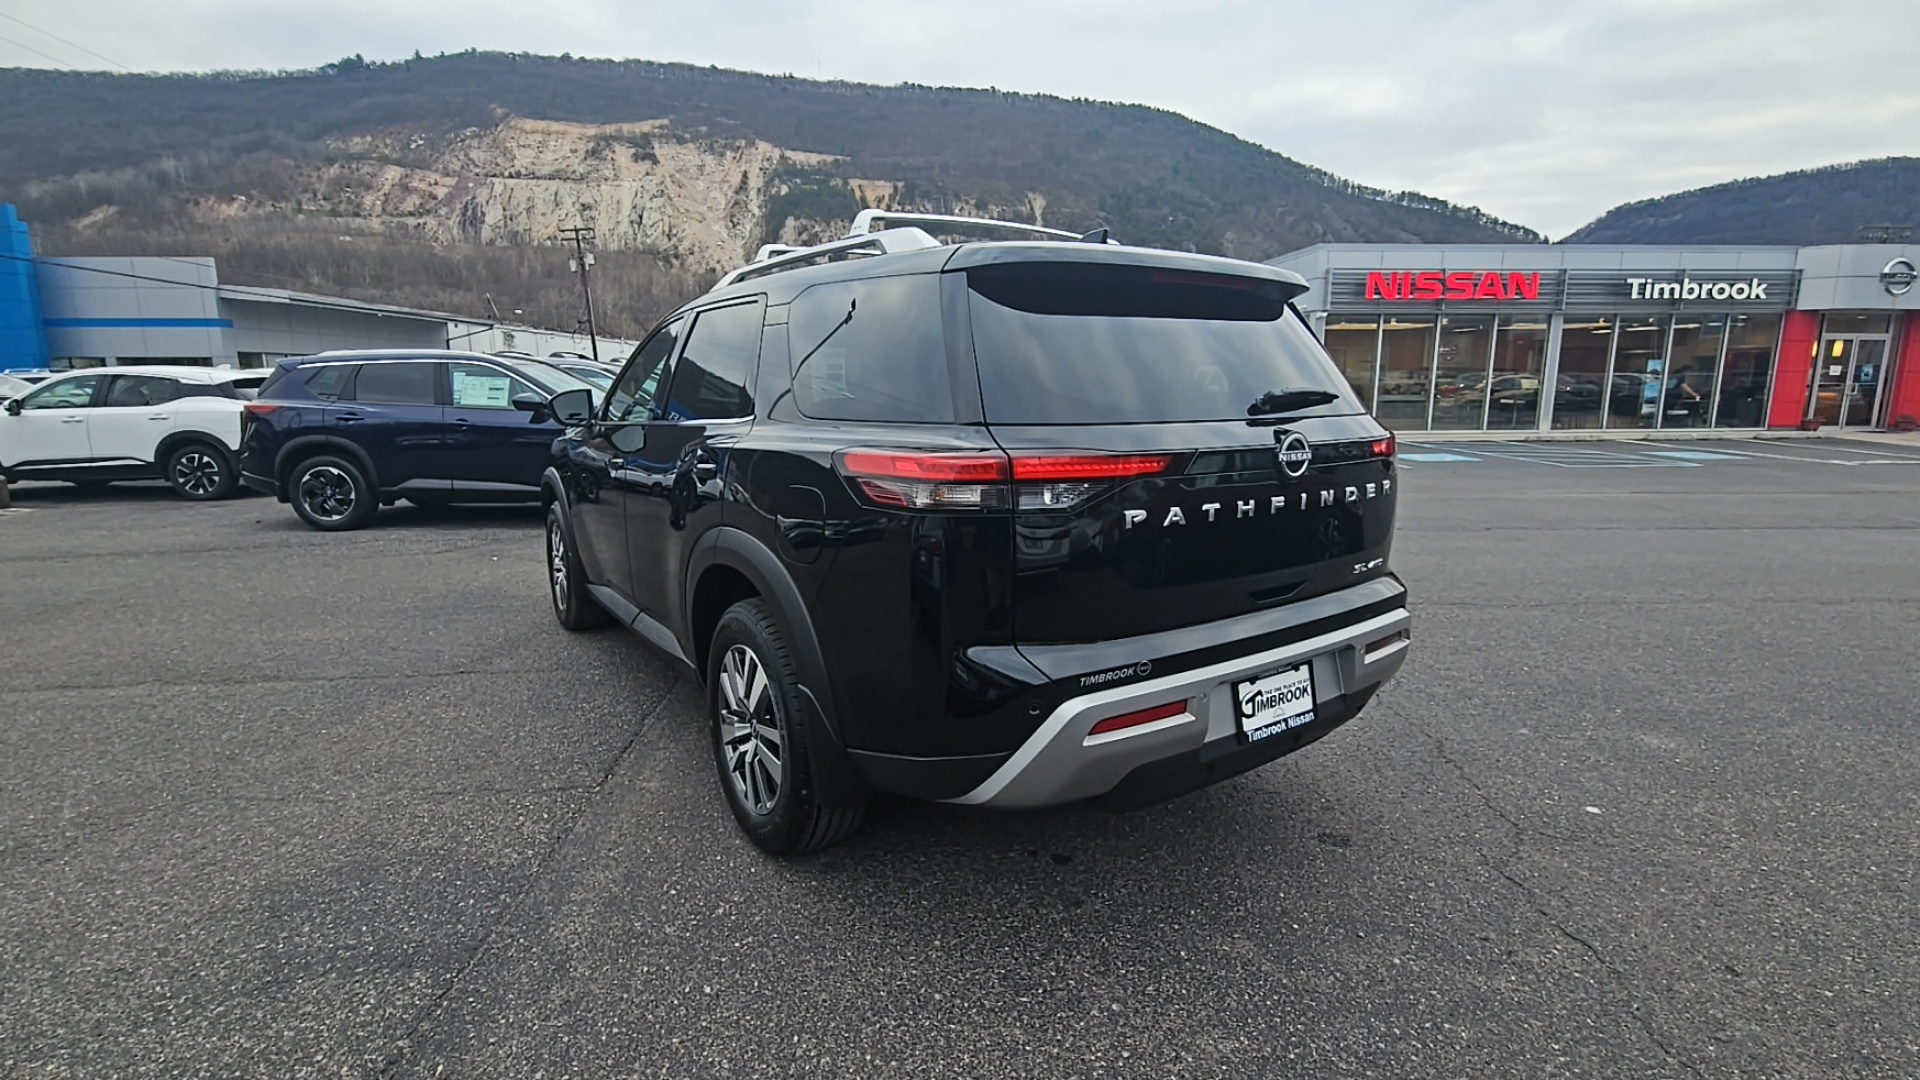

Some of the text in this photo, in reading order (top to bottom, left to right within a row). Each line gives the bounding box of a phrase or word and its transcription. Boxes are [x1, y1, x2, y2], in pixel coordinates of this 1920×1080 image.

[1365, 272, 1540, 300] NISSAN
[1627, 278, 1768, 300] Timbrook
[1278, 452, 1312, 461] NISSAN
[1123, 480, 1392, 529] PATHFINDER
[1080, 666, 1136, 687] TIMBROOK
[1241, 684, 1310, 718] TIMBROOK
[1247, 712, 1314, 742] Timbrook Nissan
